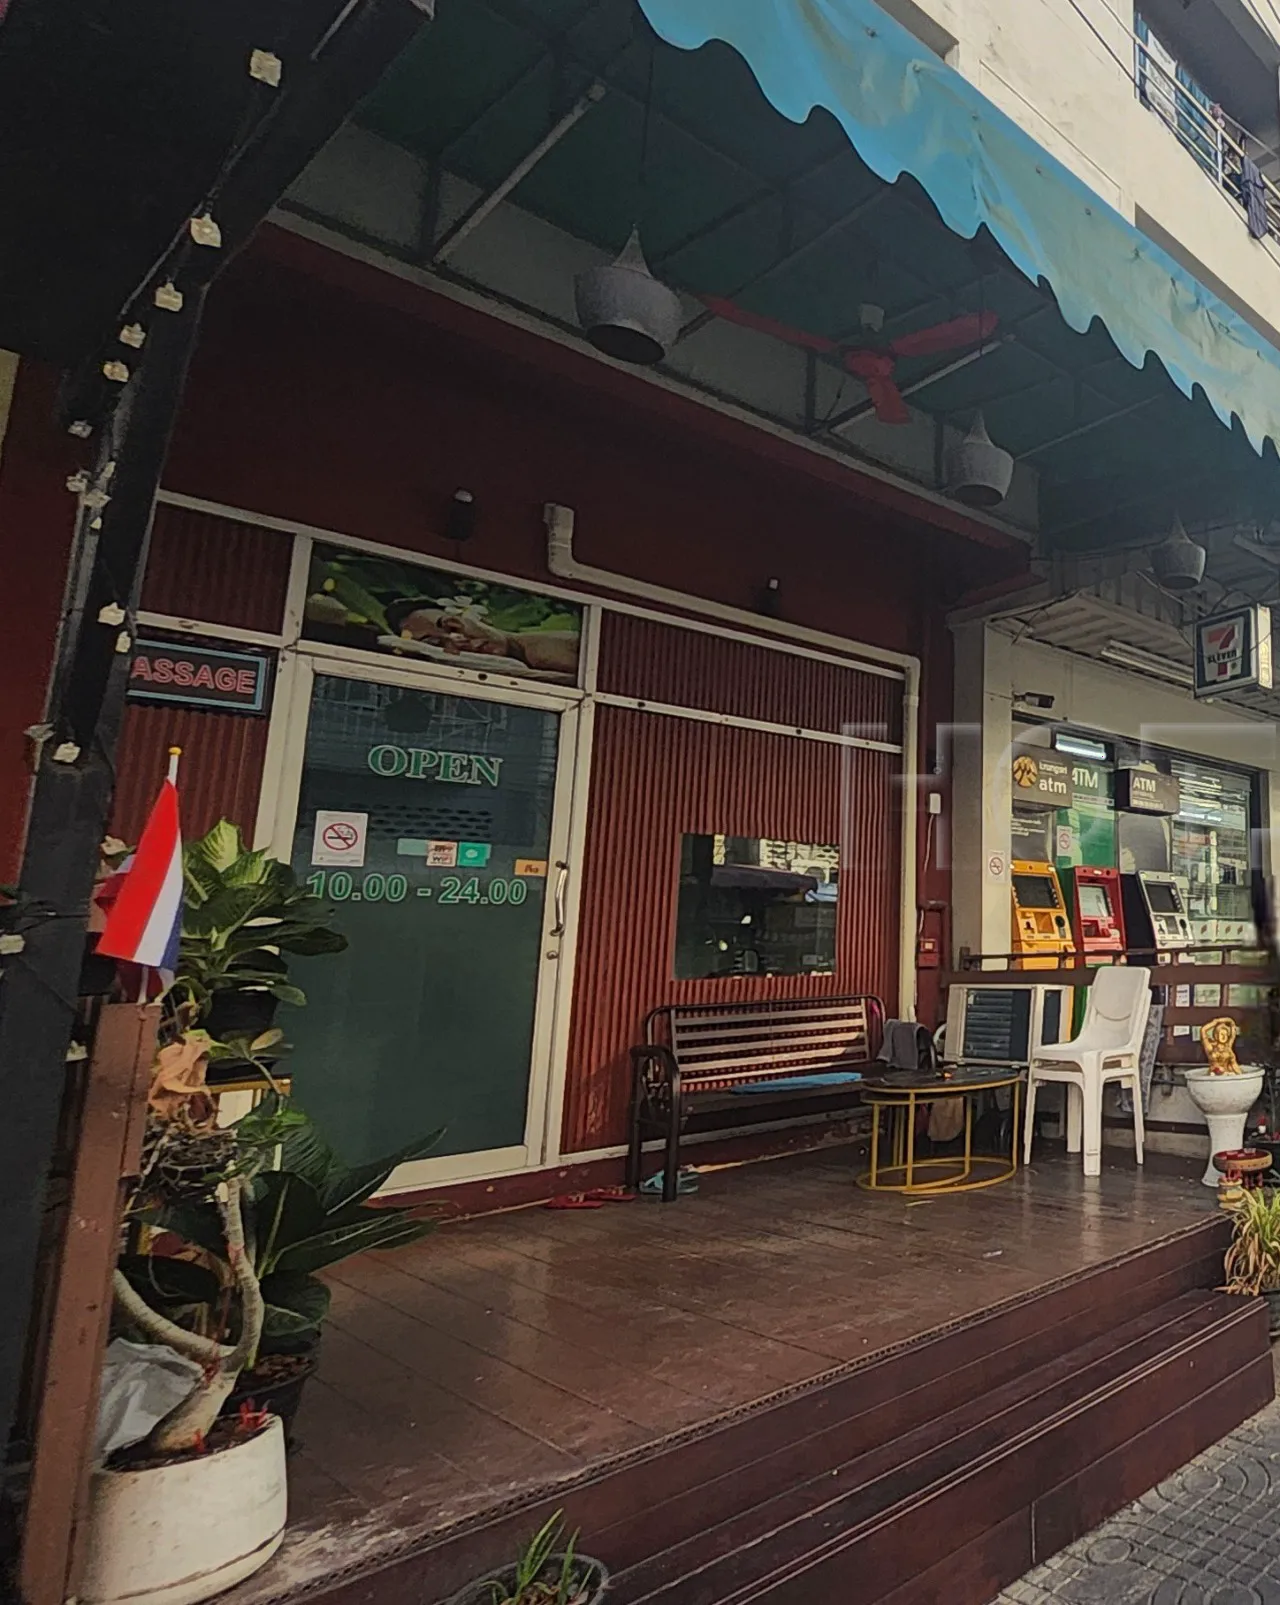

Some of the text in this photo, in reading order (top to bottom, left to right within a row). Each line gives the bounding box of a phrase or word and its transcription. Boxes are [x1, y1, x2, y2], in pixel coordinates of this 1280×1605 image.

[130, 655, 256, 695] ASSAGE
[367, 744, 504, 787] OPEN
[1038, 777, 1067, 794] atm
[1133, 776, 1156, 793] ATM
[306, 871, 528, 905] 10.00 - 24.00
